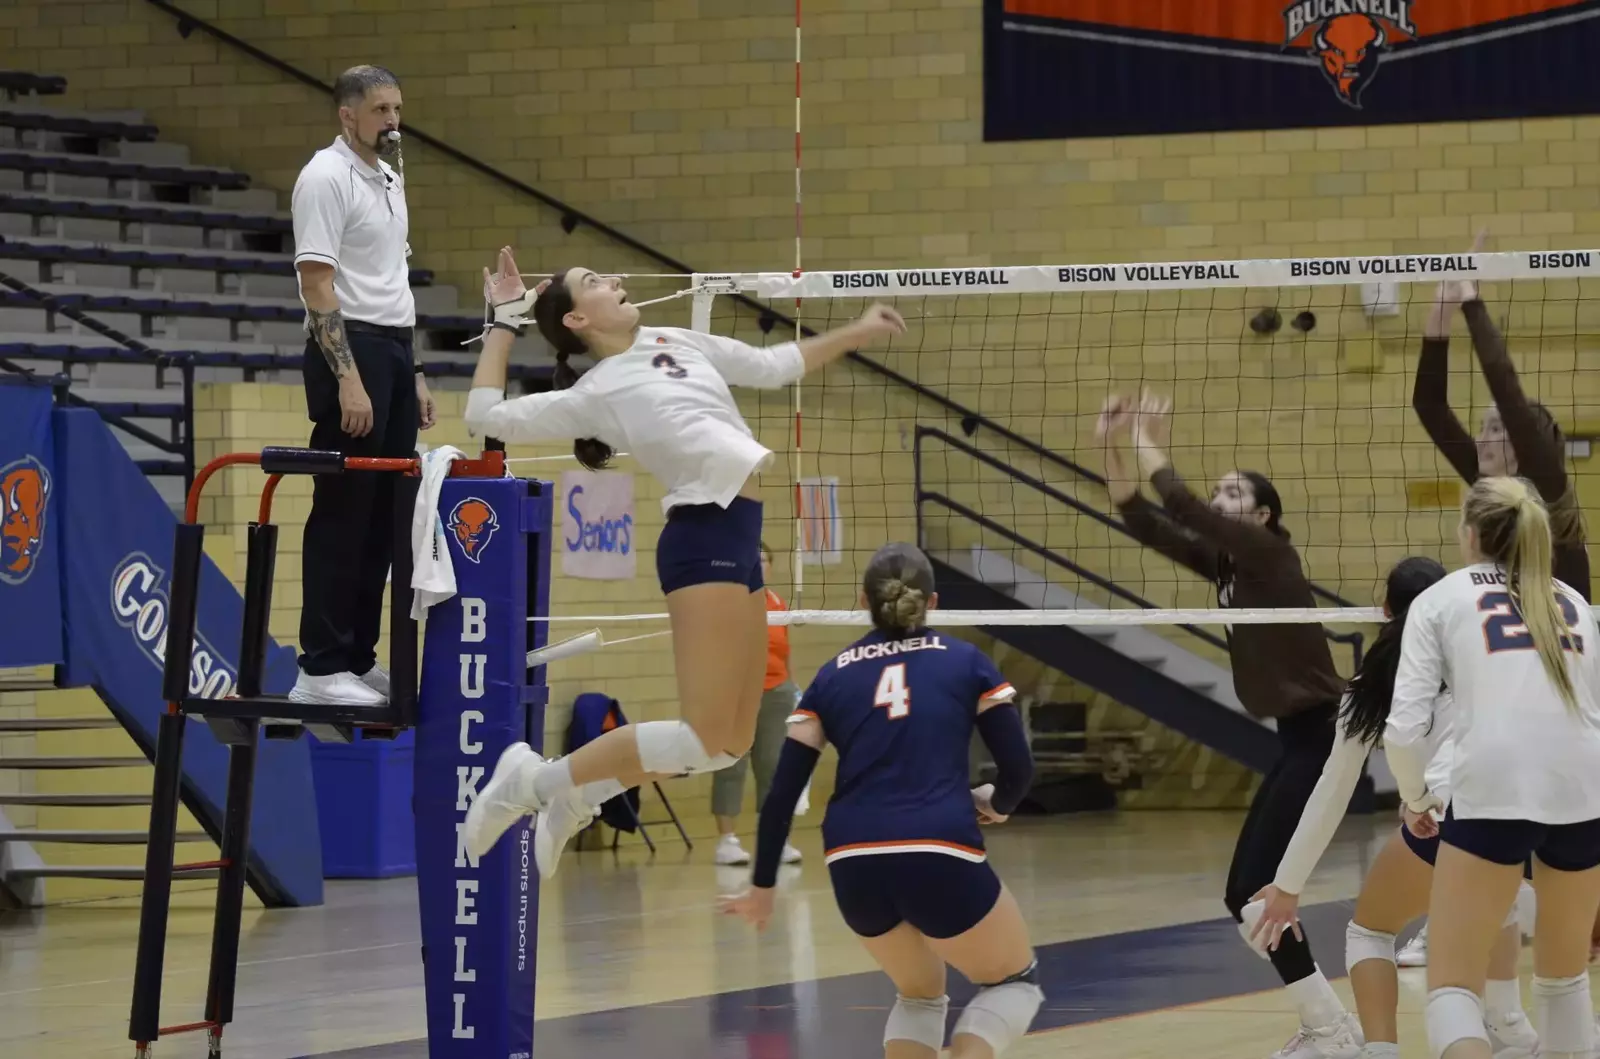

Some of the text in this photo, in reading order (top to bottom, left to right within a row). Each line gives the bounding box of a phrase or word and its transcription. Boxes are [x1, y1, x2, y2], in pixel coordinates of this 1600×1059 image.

[1287, 0, 1414, 39] BUCKNELL
[1058, 264, 1239, 282] BISON VOLLEYBALL
[1290, 256, 1477, 277] BISON VOLLEYBALL
[1529, 252, 1590, 268] BISON
[832, 270, 1009, 288] BISON VOLLEYBALL
[651, 352, 688, 379] 3
[566, 485, 633, 556] Seniors
[836, 636, 947, 669] BUCKNELL
[874, 662, 910, 720] 4
[519, 829, 530, 892] sports
